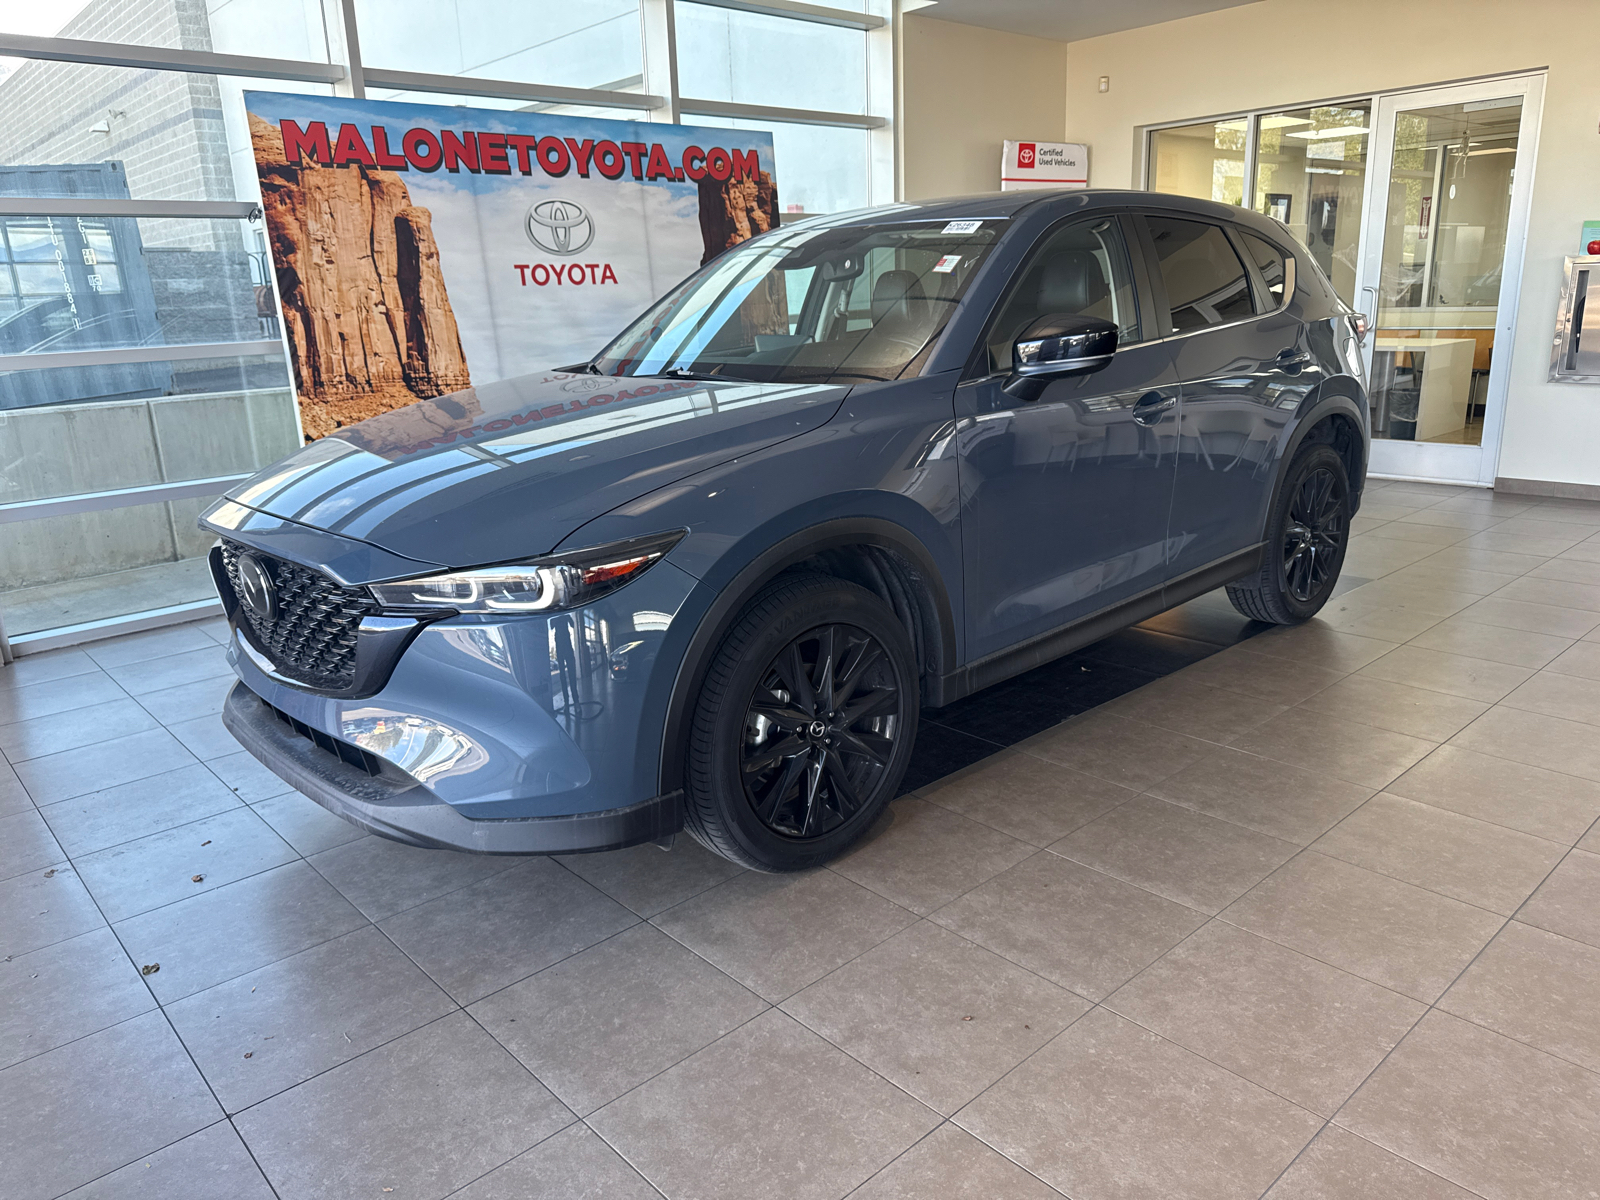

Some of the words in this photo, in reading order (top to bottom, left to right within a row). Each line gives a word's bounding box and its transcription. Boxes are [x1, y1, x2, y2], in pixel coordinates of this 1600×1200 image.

[279, 119, 761, 184] MALONETOYOTA.COM
[1039, 148, 1063, 156] Certified
[1054, 158, 1076, 166] Vehicles
[513, 263, 618, 286] TOYOTA
